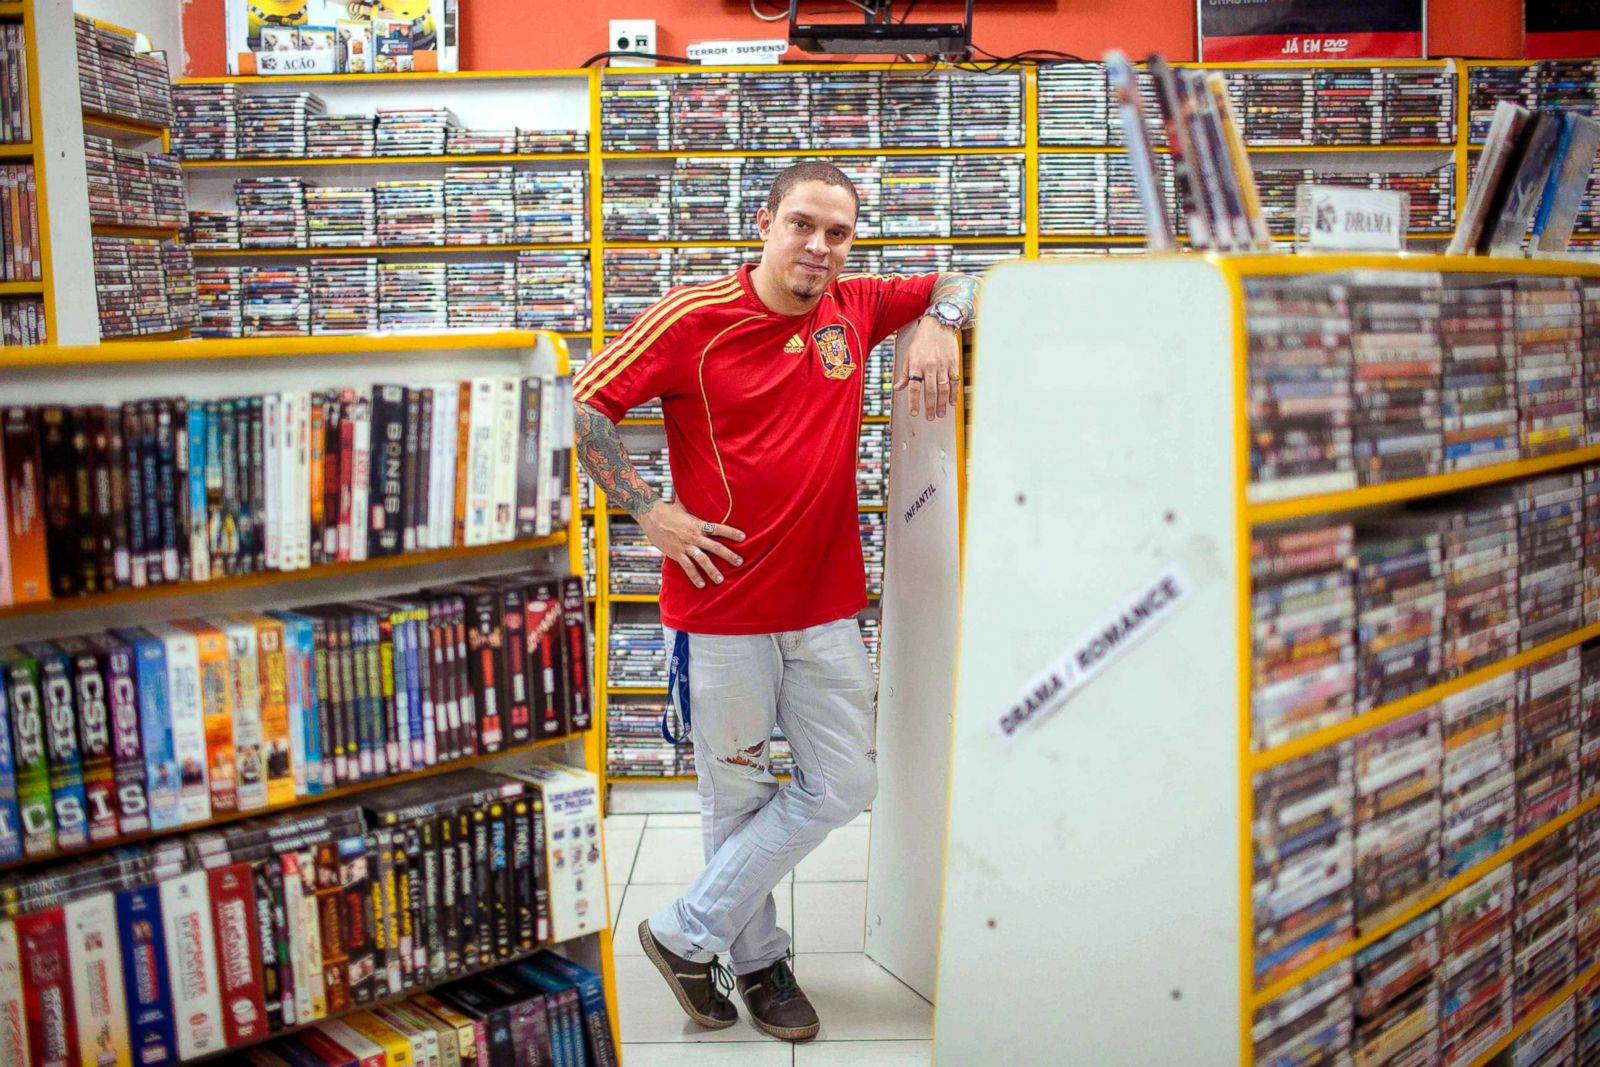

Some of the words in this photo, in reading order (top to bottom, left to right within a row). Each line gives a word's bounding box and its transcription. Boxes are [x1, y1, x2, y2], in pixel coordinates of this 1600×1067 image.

[283, 58, 315, 71] AÇÃO
[688, 47, 728, 56] TERROR
[1281, 37, 1299, 54] JÁ
[1303, 39, 1320, 53] EM
[1322, 39, 1349, 52] DVD
[1344, 211, 1391, 233] DRAMA
[385, 422, 402, 513] BONES
[904, 483, 937, 524] INFANTIL
[1000, 674, 1064, 736] DRAMA
[1075, 573, 1183, 671] ROMANCE
[55, 796, 84, 828] S
[88, 788, 112, 821] I
[119, 784, 147, 814] S
[384, 868, 399, 949] HOMELAND
[408, 868, 420, 910] HELIX
[230, 899, 253, 985] DESPERATE
[257, 899, 276, 965] DEFIANCE
[179, 913, 198, 1000] HOUSEWIVES
[190, 912, 208, 995] DESPERATE
